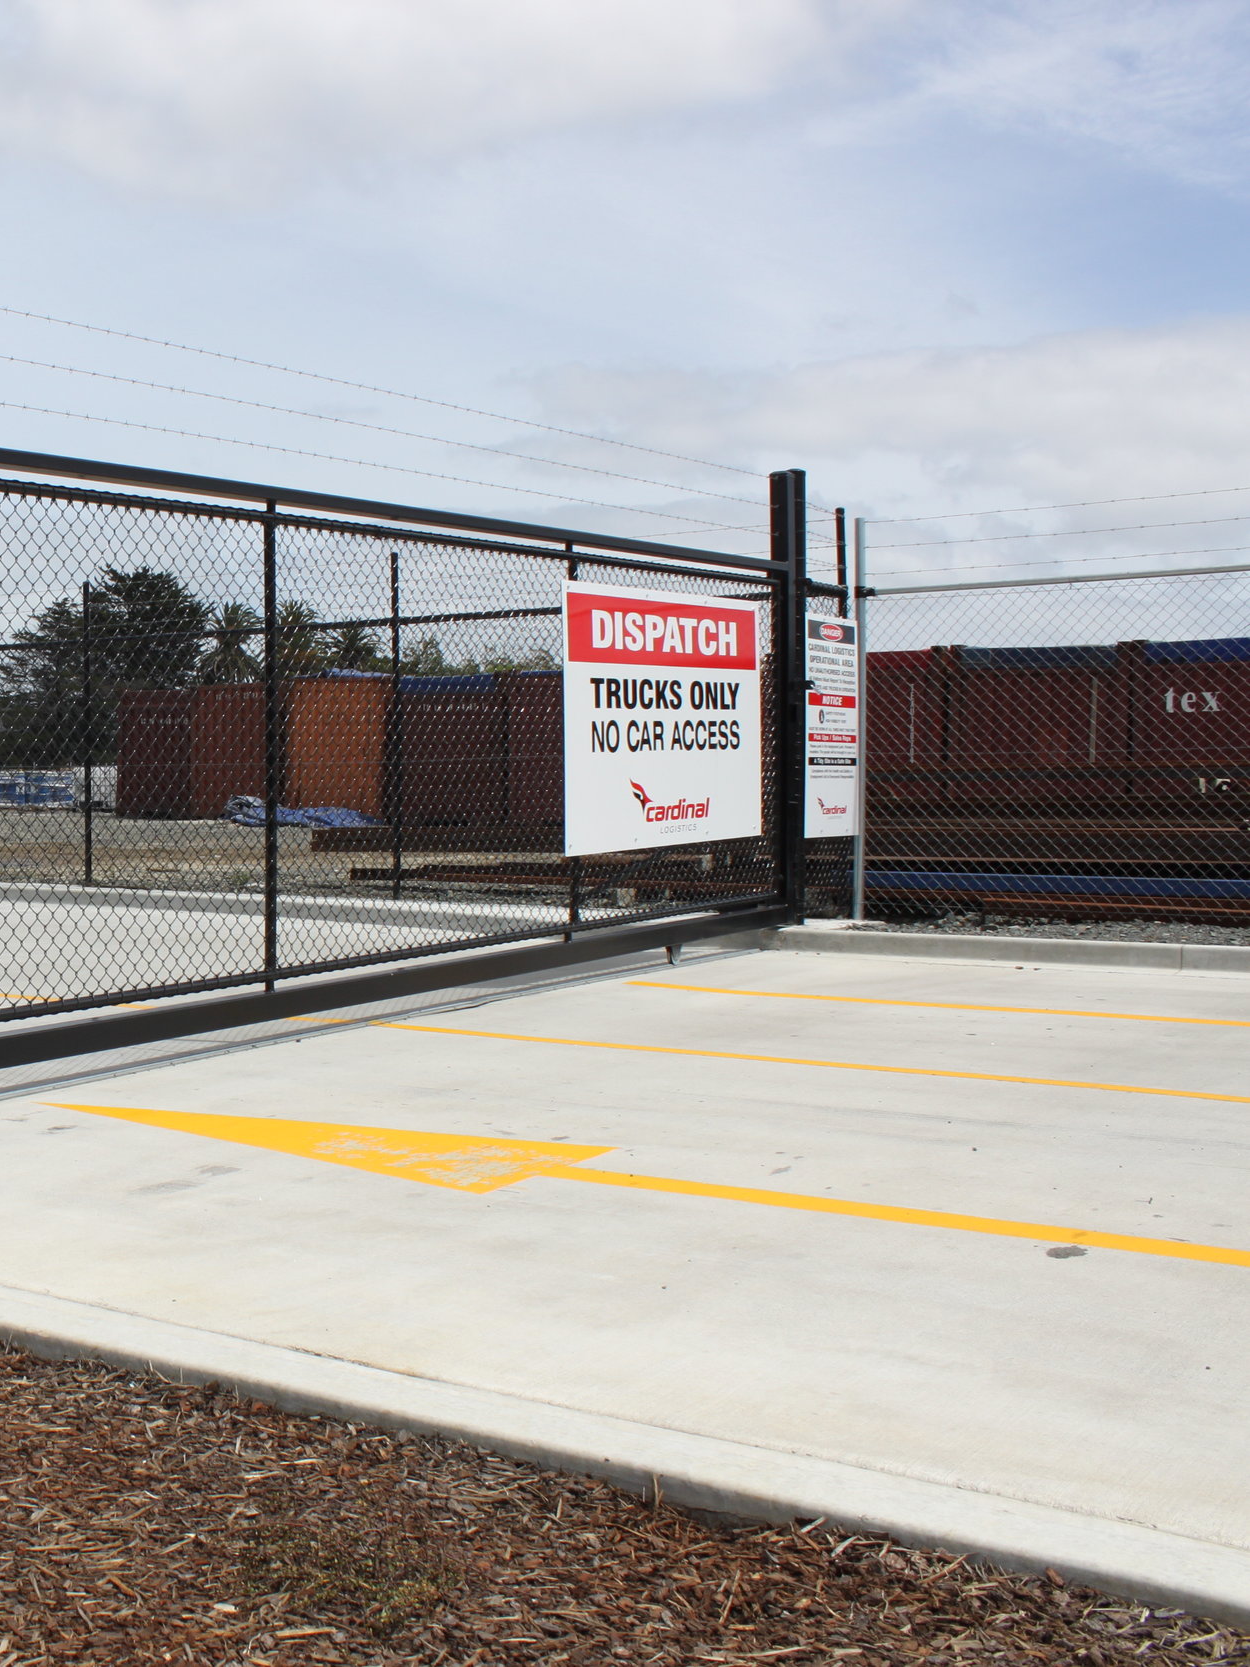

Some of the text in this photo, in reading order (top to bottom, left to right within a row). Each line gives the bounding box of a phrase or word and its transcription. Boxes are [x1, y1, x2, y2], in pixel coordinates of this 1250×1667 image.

[591, 609, 738, 656] DISPATCH
[820, 627, 842, 637] DANGER
[808, 643, 855, 657] CARDINAL LOGISTICS
[810, 655, 854, 668] OPERATIONAL AREA
[590, 678, 740, 710] TRUCKS ONLY
[822, 695, 843, 705] NOTICE
[1164, 687, 1221, 713] tex
[591, 719, 740, 752] NO CAR ACCESS
[646, 797, 710, 822] cardinal
[822, 805, 847, 814] cardinal
[660, 824, 697, 834] LOGISTICS
